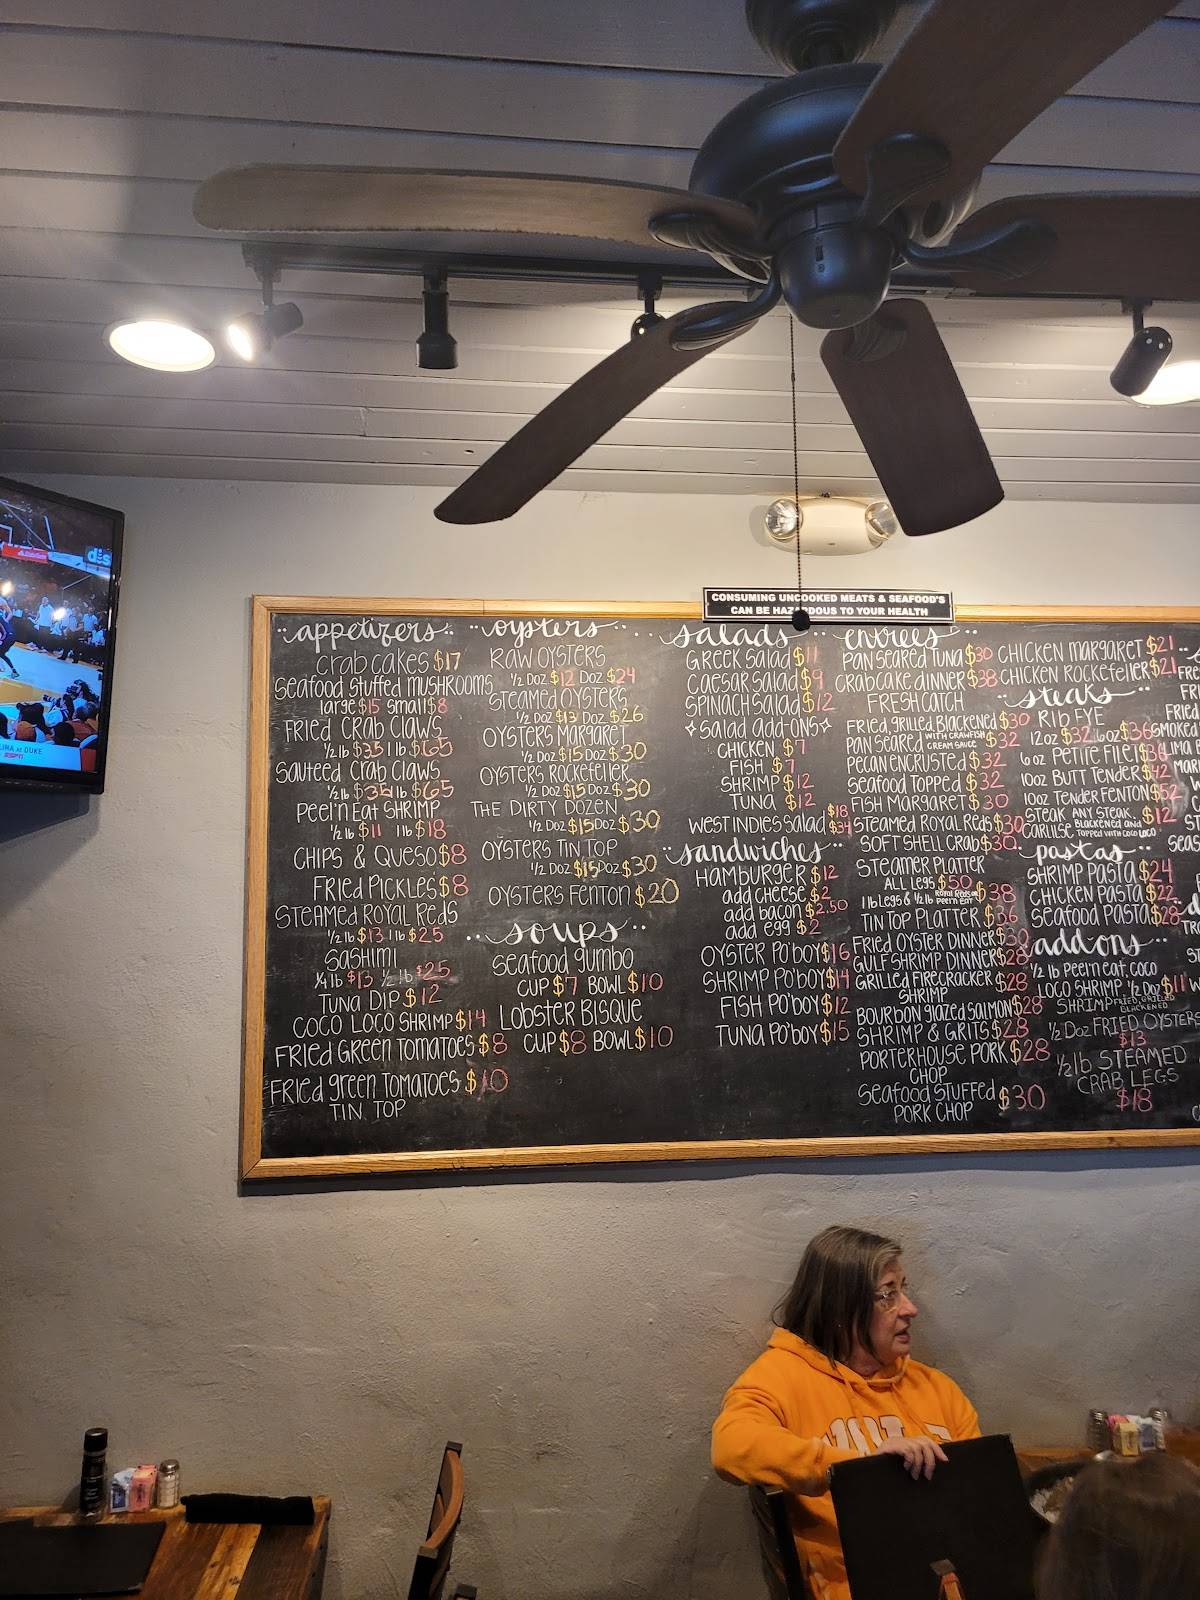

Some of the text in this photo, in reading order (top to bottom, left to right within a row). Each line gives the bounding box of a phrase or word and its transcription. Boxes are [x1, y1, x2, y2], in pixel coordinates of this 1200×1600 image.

[711, 593, 946, 604] CONSUMING UNCOOKED MEATS & SEAFOOD'S
[730, 606, 754, 615] CAN
[755, 606, 770, 615] BE
[840, 607, 854, 615] TO
[856, 607, 885, 616] YOUR
[888, 607, 928, 616] HEALTH
[283, 618, 452, 653] appetizers
[482, 618, 618, 648] oysters
[659, 624, 809, 649] salads
[832, 626, 961, 650] entrees
[965, 643, 993, 667] $30
[1146, 635, 1174, 656] $21
[433, 649, 461, 672] $17
[792, 646, 818, 668] $11
[1150, 657, 1177, 678] $21
[550, 666, 636, 686] $12 $24
[799, 667, 824, 691] $9
[967, 668, 998, 689] $38
[320, 700, 356, 716] large
[358, 697, 382, 716] $15
[427, 697, 448, 716] $8
[802, 689, 836, 714] $12
[867, 693, 920, 714] FRESH
[1005, 684, 1136, 709] steaks
[609, 705, 643, 724] $26
[999, 711, 1029, 731] $30
[409, 736, 453, 759] $65
[782, 737, 805, 758] $7
[925, 732, 947, 740] WITH
[985, 730, 1020, 749] $32
[927, 742, 954, 750] CREAM
[558, 741, 647, 763] $15 $30
[969, 750, 1007, 772] $32
[730, 756, 795, 776] FISH $7
[721, 772, 815, 793] SHRIMP $12
[966, 771, 1005, 792] $32
[1053, 769, 1086, 787] BUTT
[612, 779, 650, 800] $30
[384, 800, 441, 820] SHRIMP
[470, 800, 557, 818] THE DIRTY
[784, 792, 816, 812] $12
[827, 803, 848, 818] $18
[851, 793, 1008, 812] FISH $30
[568, 809, 661, 836] $15 $30
[993, 813, 1023, 834] $30
[1072, 805, 1177, 825] ANY $12
[359, 819, 447, 841] $11 $18
[1138, 828, 1157, 838] LOCO
[557, 838, 618, 858] TIN TOP
[665, 836, 832, 867] sandwiches
[861, 835, 944, 852] SOFT SHELL
[1018, 840, 1136, 866] pastas
[293, 842, 467, 869] CHIPS & $8
[622, 854, 658, 879] $30
[810, 864, 839, 887] $12
[884, 874, 972, 890] ALL $50
[1027, 858, 1173, 886] SHRIMP $24
[438, 874, 469, 898] $8
[635, 877, 680, 909] $20
[722, 886, 831, 905] add $2
[1145, 882, 1178, 903] $22
[724, 904, 755, 923] add
[805, 899, 849, 919] $2.50
[485, 920, 628, 948] soups
[725, 918, 822, 941] add egg $2
[861, 914, 883, 932] TIN
[357, 927, 444, 944] $13 $25
[821, 942, 850, 964] $16
[853, 952, 941, 974] GULF SHRIMP
[1130, 961, 1157, 977] COCO
[517, 970, 664, 997] CUP $7 BOWL $10
[703, 967, 849, 994] SHRIMP $14
[995, 971, 1027, 993] $28
[1038, 974, 1185, 998] LOCO $11
[369, 983, 443, 1011] DIP $12
[720, 992, 851, 1020] FISH $12
[899, 987, 949, 1005] SHRIMP
[1012, 995, 1042, 1017] $28
[1057, 996, 1113, 1014] SHRIMP
[1120, 1002, 1168, 1013] BLACKENED
[293, 1008, 487, 1039] COCO LOCO SHRIMP $14
[819, 1018, 850, 1046] $15
[857, 1018, 1029, 1047] SHRIMP & GRITS $28
[1093, 1014, 1139, 1036] FRIED
[478, 1032, 508, 1057] $8
[523, 1026, 674, 1056] CUP $8 BOWL $10
[1119, 1030, 1147, 1048] $13
[971, 1038, 1050, 1065] PORK $28
[1099, 1045, 1187, 1070] STEAMED
[910, 1065, 947, 1084] CHOP
[1077, 1068, 1179, 1095] CRAB LEGS
[998, 1084, 1045, 1111] $30
[1117, 1087, 1153, 1111] $18
[329, 1099, 406, 1121] TIN TOP
[894, 1101, 973, 1123] PORK CHOP
